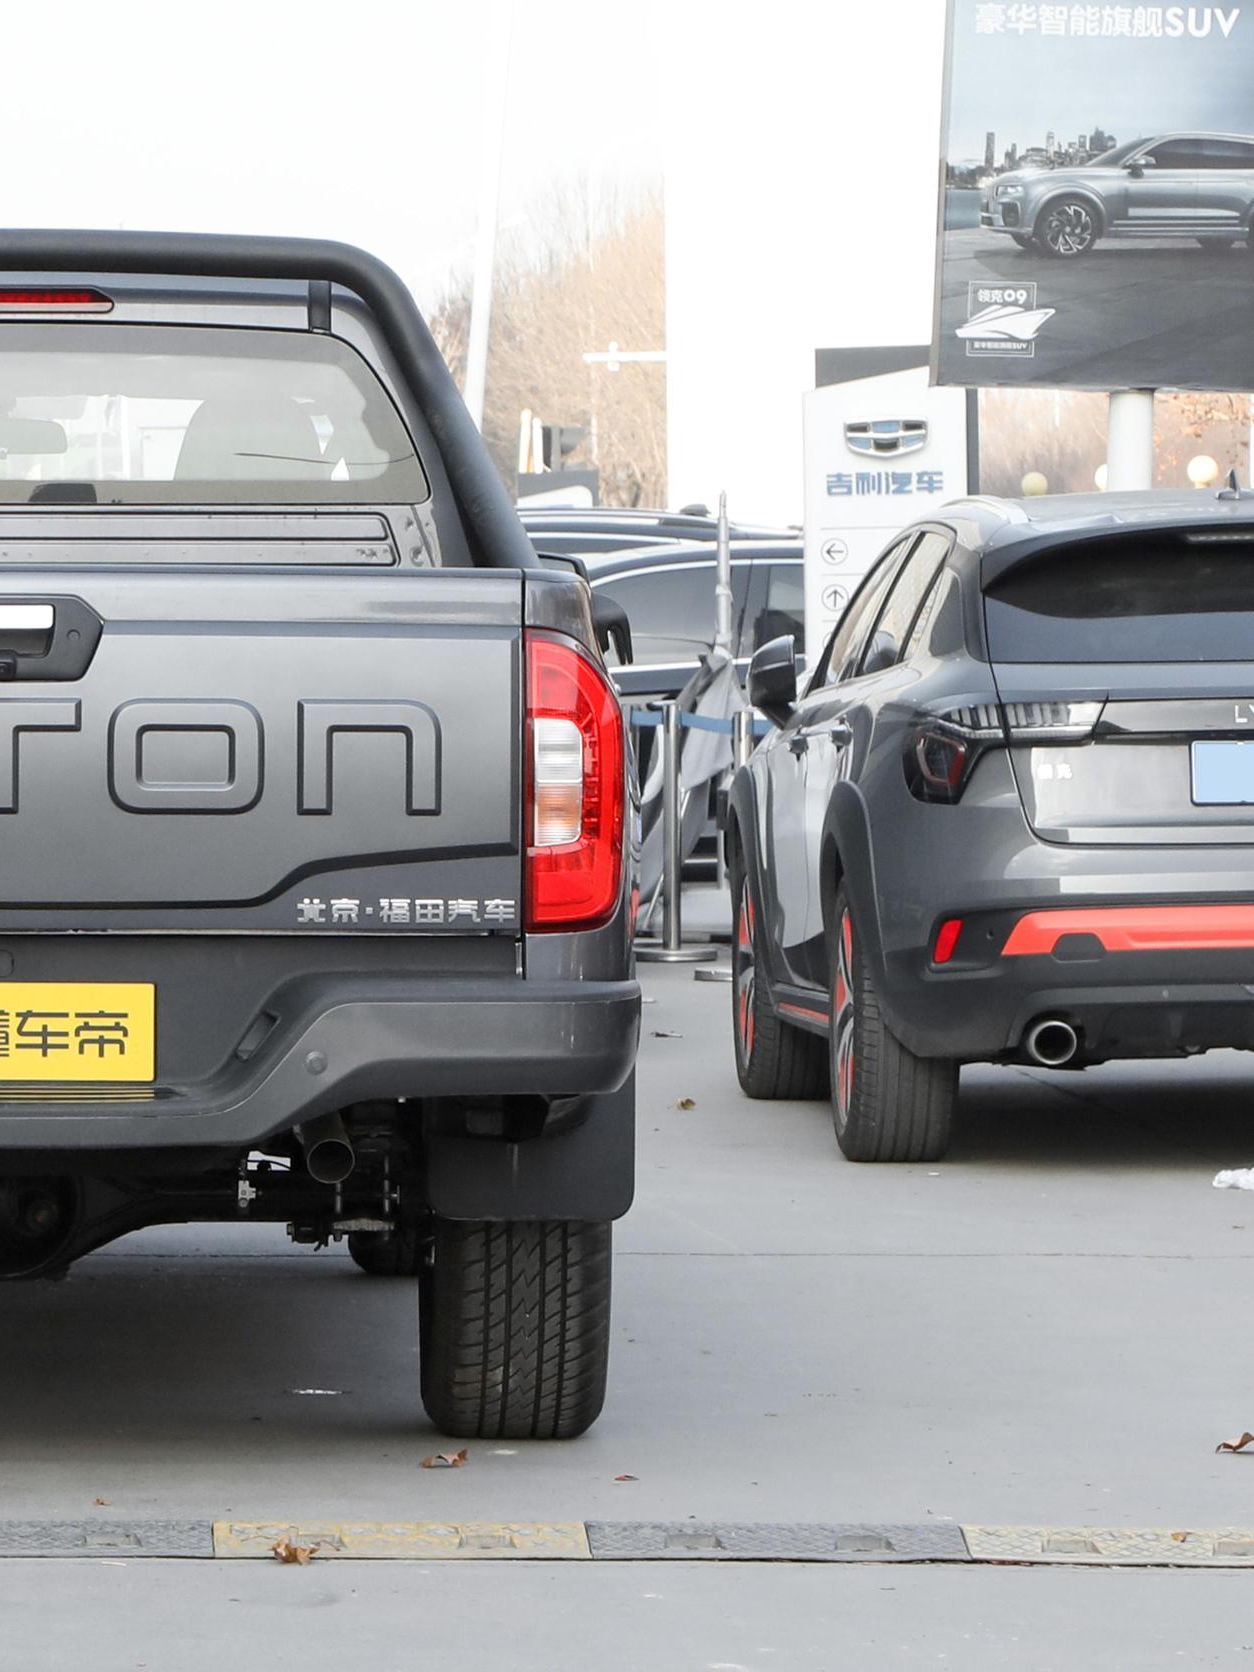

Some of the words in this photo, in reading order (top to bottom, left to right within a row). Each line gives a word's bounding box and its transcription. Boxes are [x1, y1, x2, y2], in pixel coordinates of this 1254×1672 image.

[975, 4, 1240, 38] 豪华智能旗舰SUV
[826, 471, 944, 496] 吉利汽车
